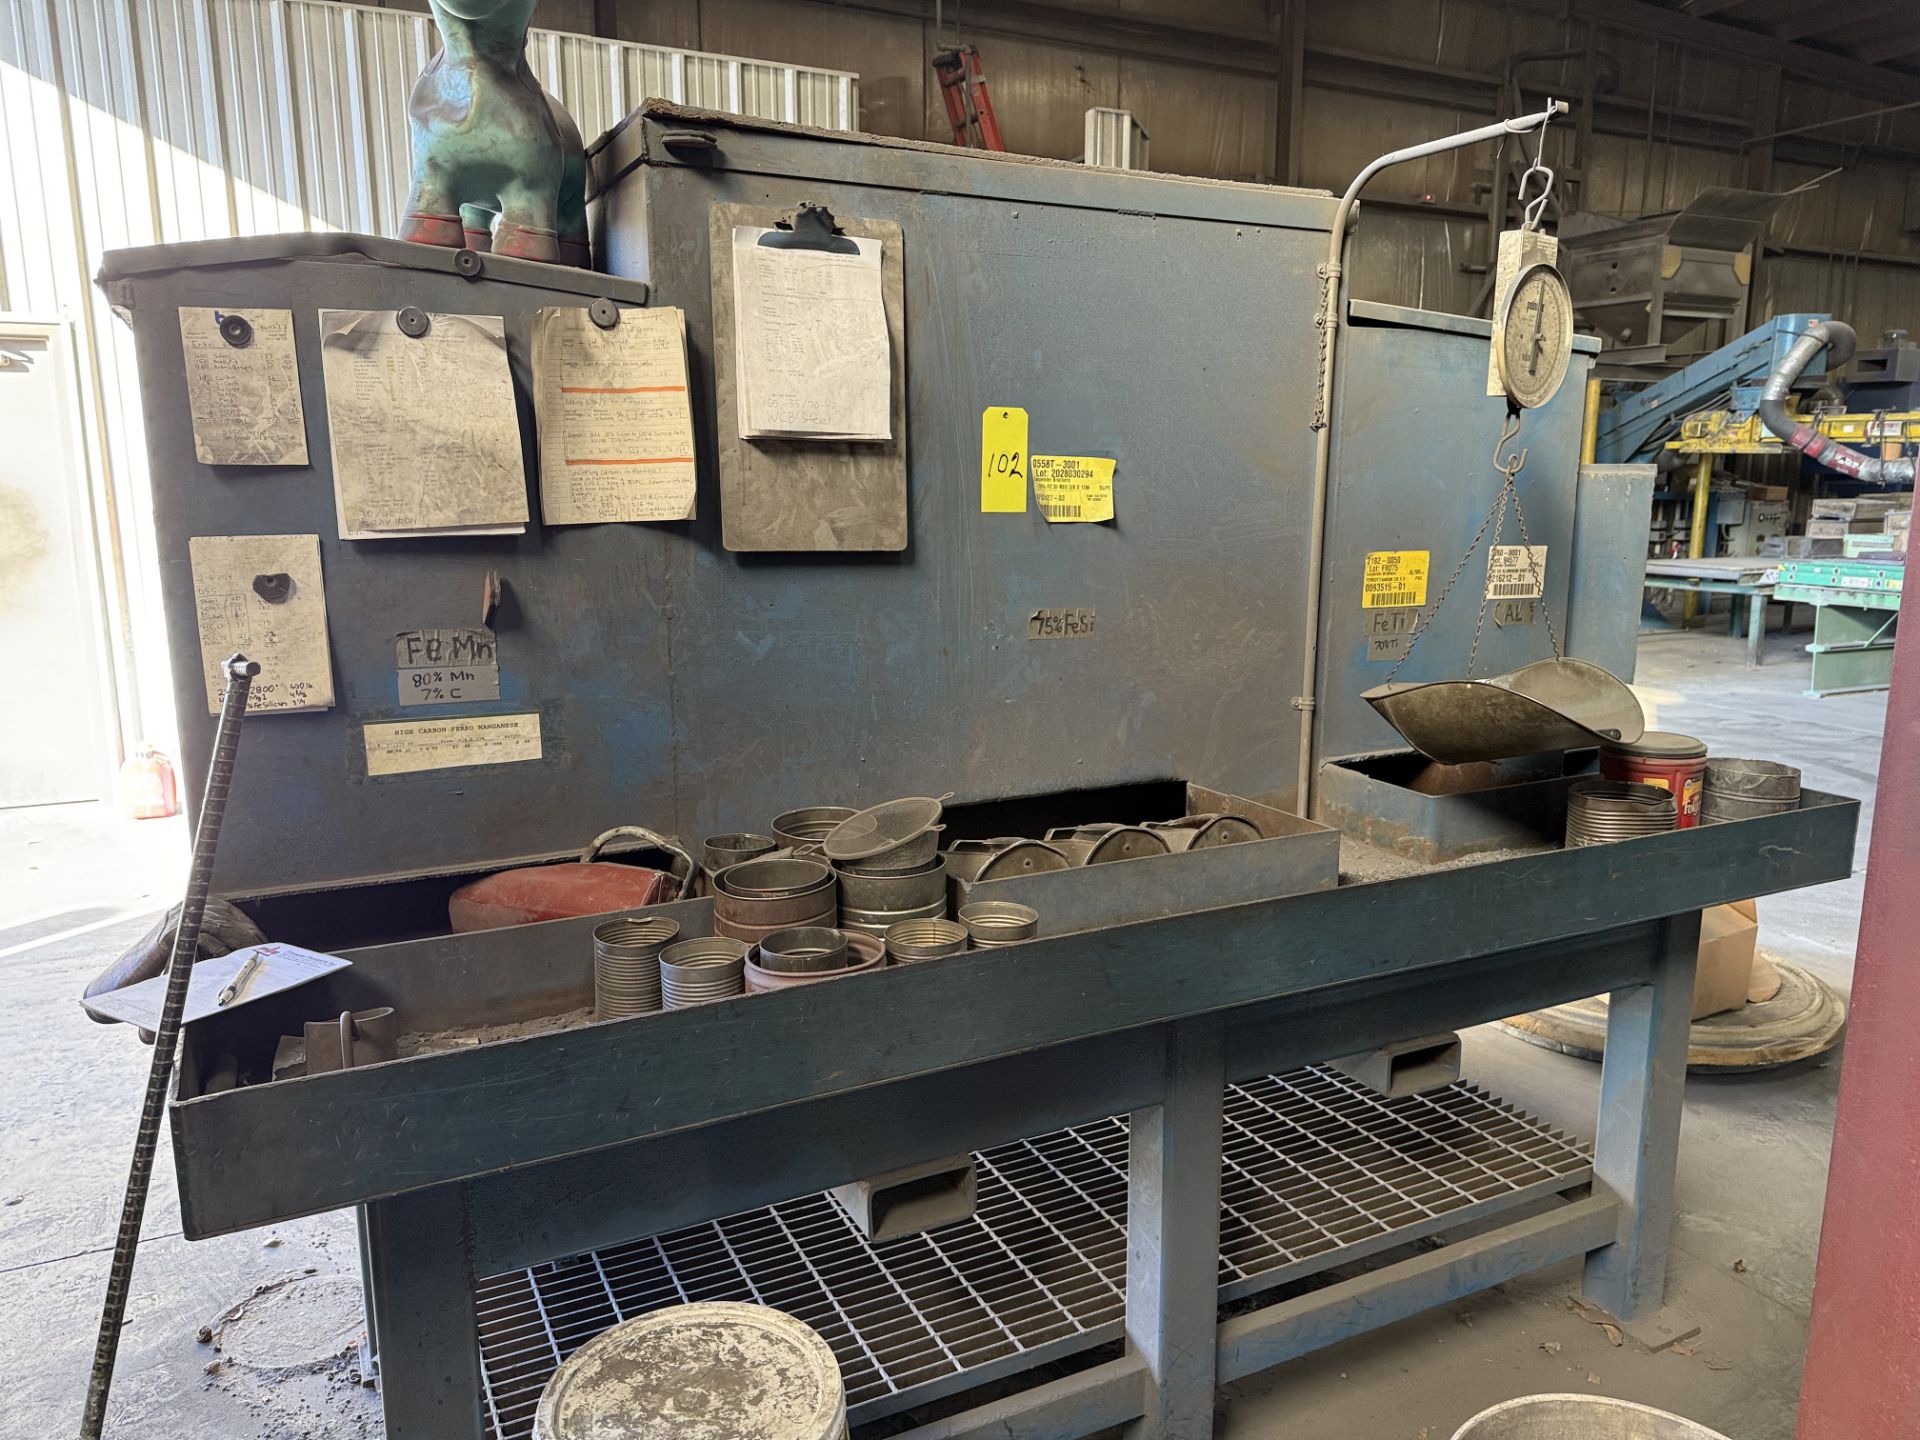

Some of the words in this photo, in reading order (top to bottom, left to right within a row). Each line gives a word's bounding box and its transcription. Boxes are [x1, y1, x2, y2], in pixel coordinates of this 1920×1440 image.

[988, 452, 1023, 479] 102
[412, 670, 443, 688] 80%
[450, 671, 475, 682] Mn
[420, 687, 444, 701] 7%
[450, 688, 462, 699] C
[394, 728, 414, 736] HIGH
[418, 726, 447, 735] CARBON
[450, 724, 475, 733] FERRO
[478, 722, 519, 732] MANGANESE
